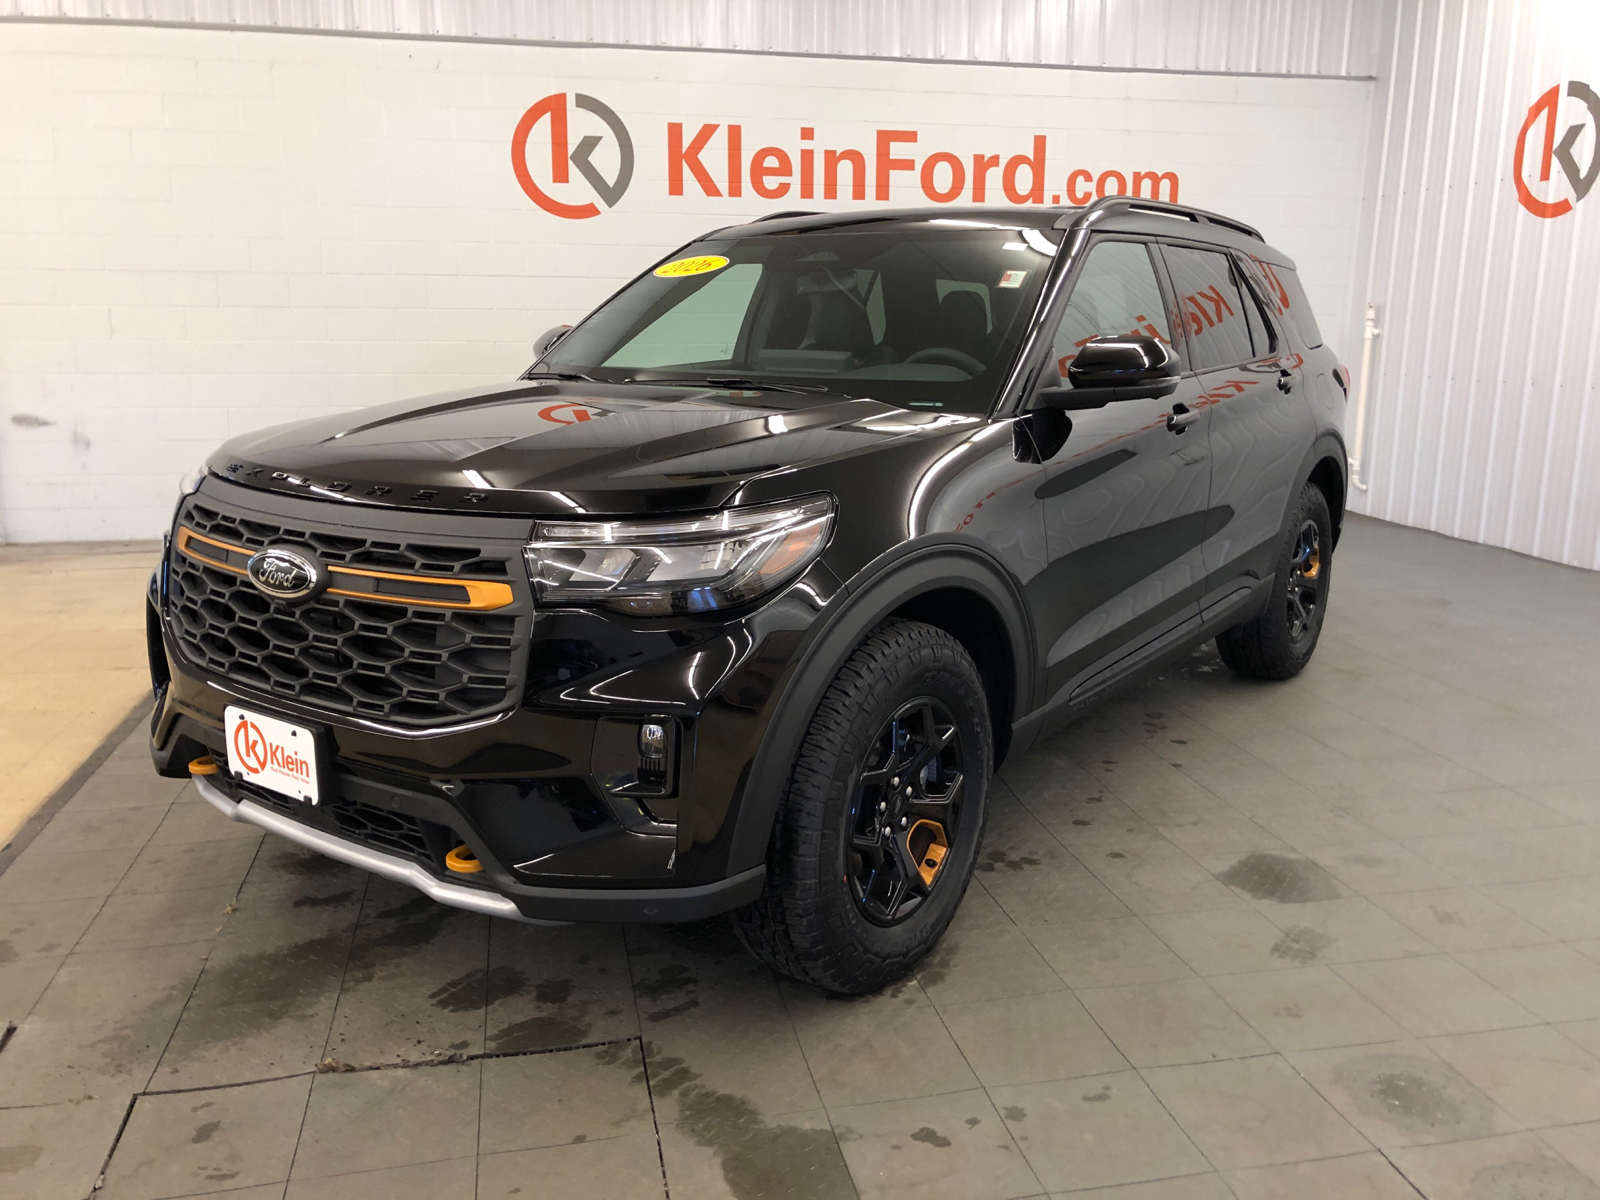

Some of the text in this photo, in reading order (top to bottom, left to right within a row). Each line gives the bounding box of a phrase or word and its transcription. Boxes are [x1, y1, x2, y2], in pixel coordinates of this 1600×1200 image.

[667, 122, 1180, 206] KleinFord.com
[660, 259, 722, 274] 2026
[225, 463, 489, 504] EXPLORER
[257, 557, 296, 589] Ford
[269, 742, 310, 778] Klein
